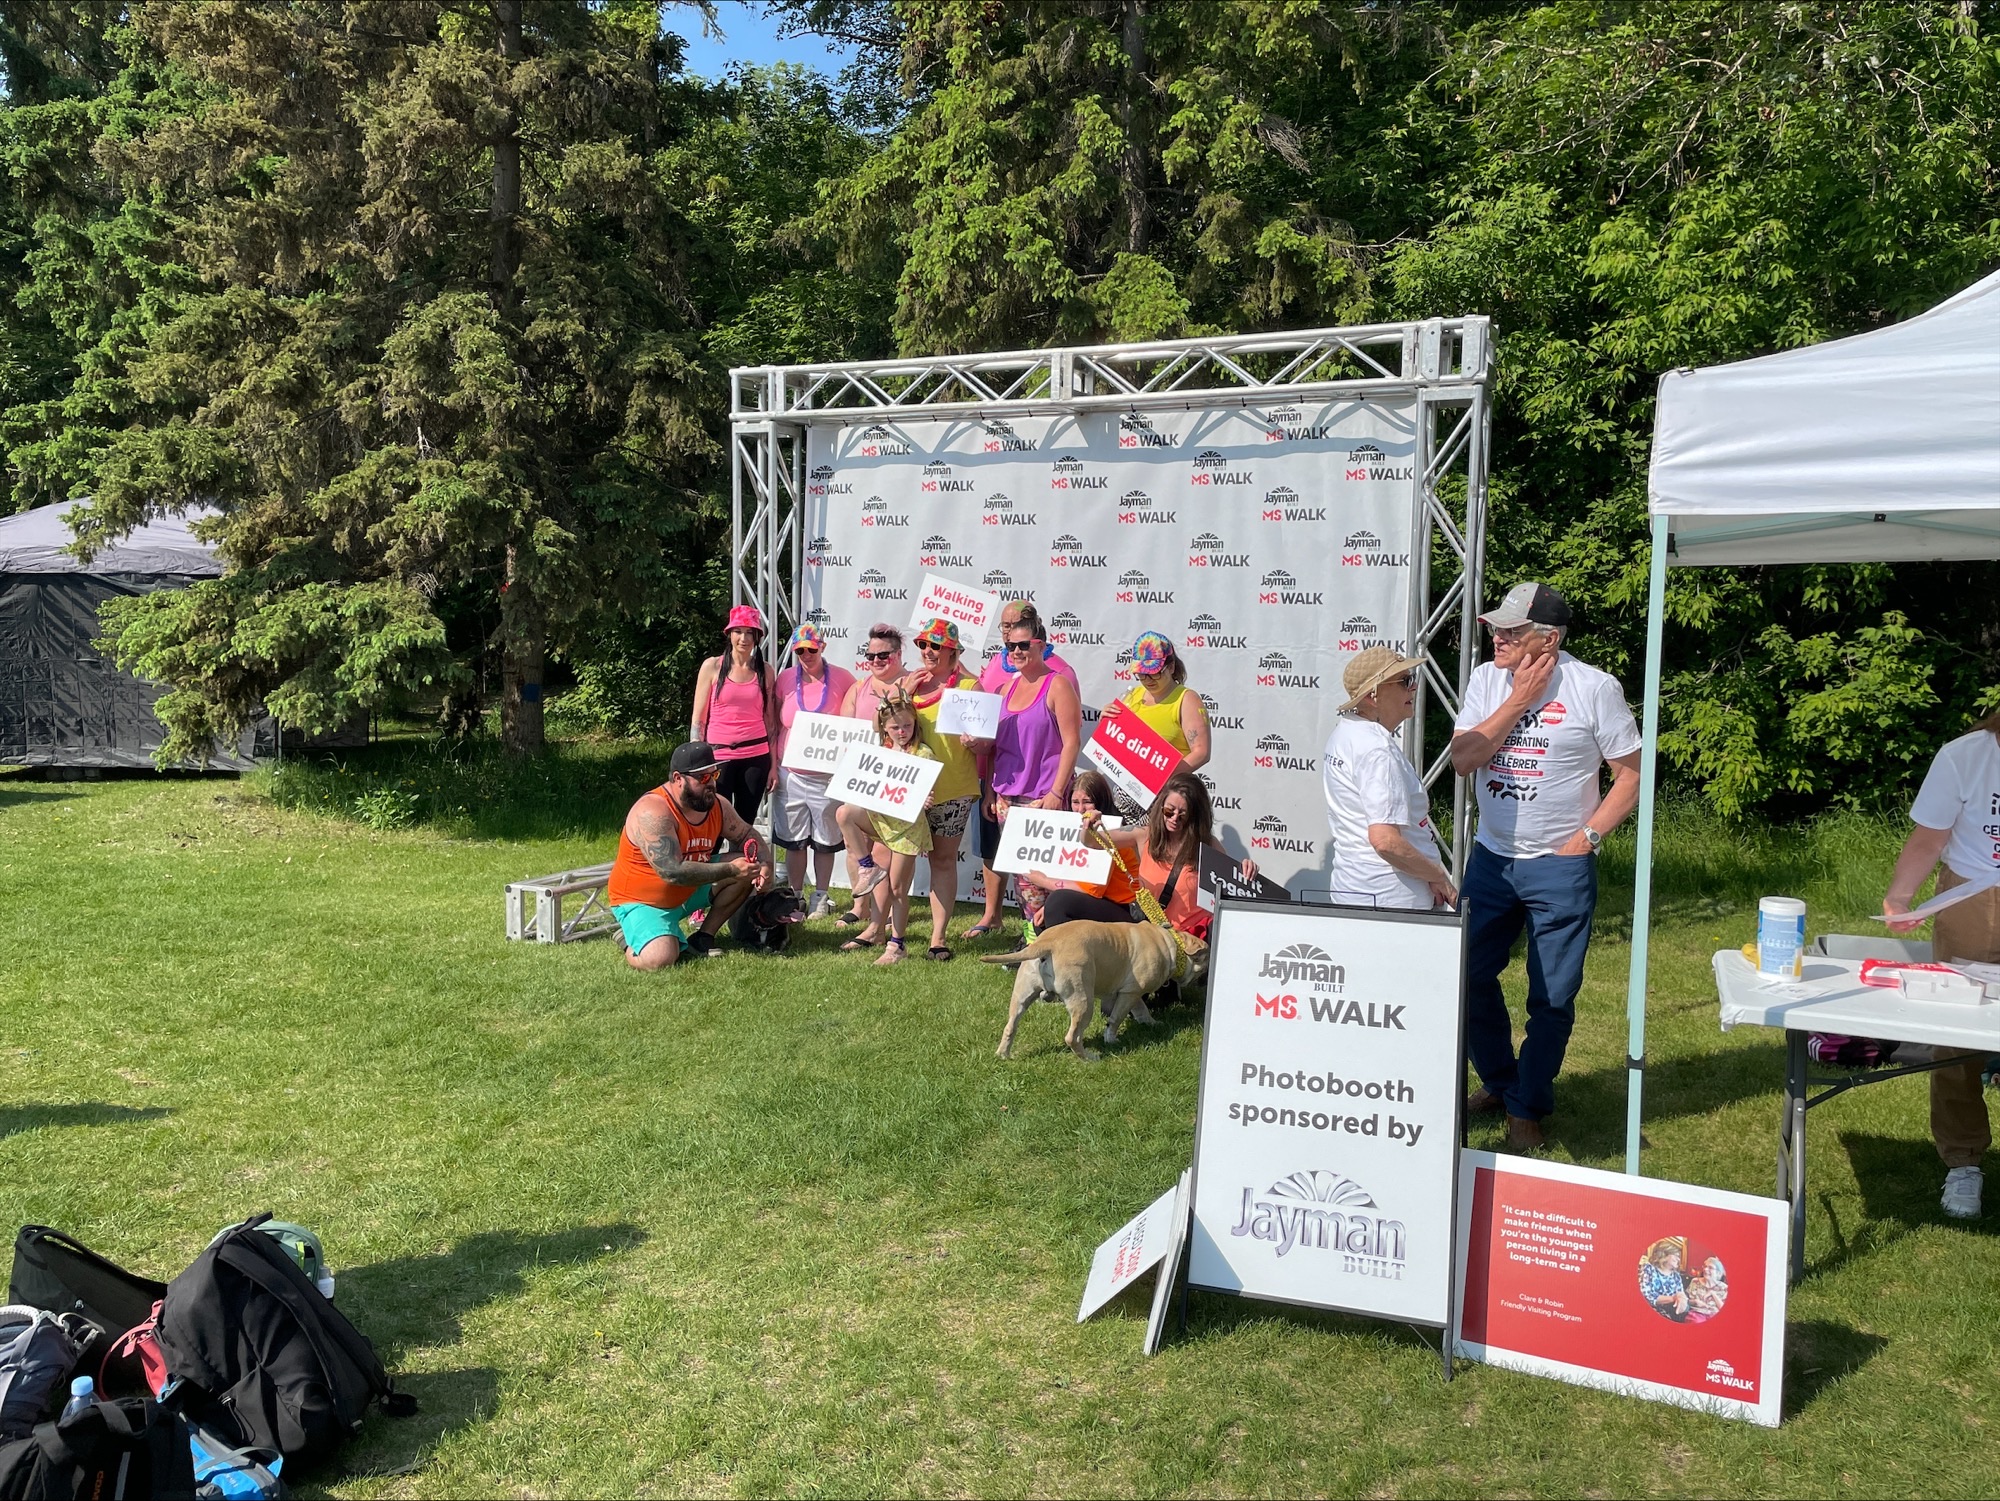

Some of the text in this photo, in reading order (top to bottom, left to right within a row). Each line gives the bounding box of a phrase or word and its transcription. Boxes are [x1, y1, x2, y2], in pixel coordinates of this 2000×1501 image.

[1267, 410, 1301, 425] Jayman
[985, 425, 1013, 438] Jayman
[1120, 418, 1153, 432] Jayman
[863, 430, 889, 443] Jayman
[1140, 434, 1178, 446] WALK
[1287, 427, 1330, 440] WALK
[880, 444, 910, 455] WALK
[1001, 440, 1037, 451] WALK
[1193, 457, 1226, 471] Jayman
[1348, 451, 1385, 465] Jayman
[923, 466, 951, 478] Jayman
[1053, 461, 1083, 475] Jayman
[1369, 467, 1413, 480] WALK
[810, 470, 835, 482] Jayman
[1213, 472, 1252, 484] WALK
[827, 483, 852, 494] WALK
[939, 480, 974, 491] WALK
[1071, 477, 1108, 489] WALK
[984, 499, 1012, 511] Jayman
[1119, 496, 1151, 509] Jayman
[1264, 492, 1298, 505] Jayman
[862, 501, 886, 512] Jayman
[1001, 514, 1036, 525] WALK
[1138, 512, 1176, 523] WALK
[1285, 508, 1326, 520] WALK
[876, 516, 909, 526] WALK
[808, 542, 832, 553] Jayman
[921, 540, 950, 552] Jayman
[1051, 540, 1082, 553] Jayman
[1190, 538, 1224, 551] Jayman
[1344, 537, 1381, 550] Jayman
[824, 556, 852, 566] WALK
[939, 556, 972, 567] WALK
[1070, 556, 1107, 567] WALK
[1210, 555, 1250, 567] WALK
[1365, 554, 1409, 566] WALK
[859, 574, 886, 585] Jayman
[983, 574, 1011, 587] Jayman
[1118, 575, 1149, 587] Jayman
[1261, 575, 1296, 588] Jayman
[874, 589, 908, 599] WALK
[933, 584, 983, 613] Walking
[1000, 590, 1035, 601] WALK
[1136, 591, 1174, 603] WALK
[1281, 592, 1323, 605] WALK
[806, 612, 830, 624] Jayman
[922, 597, 986, 626] for a cure!
[1051, 617, 1081, 629] Jayman
[1188, 619, 1221, 633] Jayman
[1340, 622, 1376, 636] Jayman
[1069, 633, 1105, 644] WALK
[1207, 636, 1247, 648] WALK
[1258, 658, 1292, 670] Jayman
[1278, 675, 1320, 688] WALK
[810, 723, 837, 740] We
[1105, 720, 1169, 770] We did it!
[1256, 739, 1290, 752] Jayman
[804, 746, 839, 761] end
[858, 753, 920, 784] We will
[1103, 757, 1122, 778] WALK
[1275, 757, 1315, 771] WALK
[847, 778, 881, 796] end
[1025, 819, 1054, 839] We
[1253, 820, 1287, 833] Jayman
[1273, 839, 1314, 853] WALK
[1017, 846, 1055, 863] end
[1258, 953, 1345, 986] Jayman
[1314, 983, 1344, 993] BUILT
[1309, 997, 1406, 1030] WALK
[1241, 1063, 1414, 1103] Photobooth
[1228, 1102, 1424, 1147] sponsored by
[1230, 1187, 1406, 1260] Jayman
[1515, 1208, 1530, 1217] can
[1533, 1210, 1544, 1219] be
[1546, 1214, 1584, 1227] difficult
[1587, 1220, 1597, 1229] to
[1504, 1218, 1592, 1240] make friends when
[1532, 1233, 1547, 1242] the
[1549, 1238, 1593, 1251] youngest
[1506, 1241, 1538, 1252] person
[1540, 1246, 1566, 1260] living
[1569, 1251, 1578, 1260] in
[1342, 1255, 1405, 1280] BUILT
[1510, 1251, 1580, 1272] long-term care
[1519, 1293, 1536, 1302] Clare
[1545, 1299, 1564, 1308] Robin
[1500, 1300, 1582, 1322] Friendly Visiting Program
[1706, 1373, 1754, 1390] MS WALK
